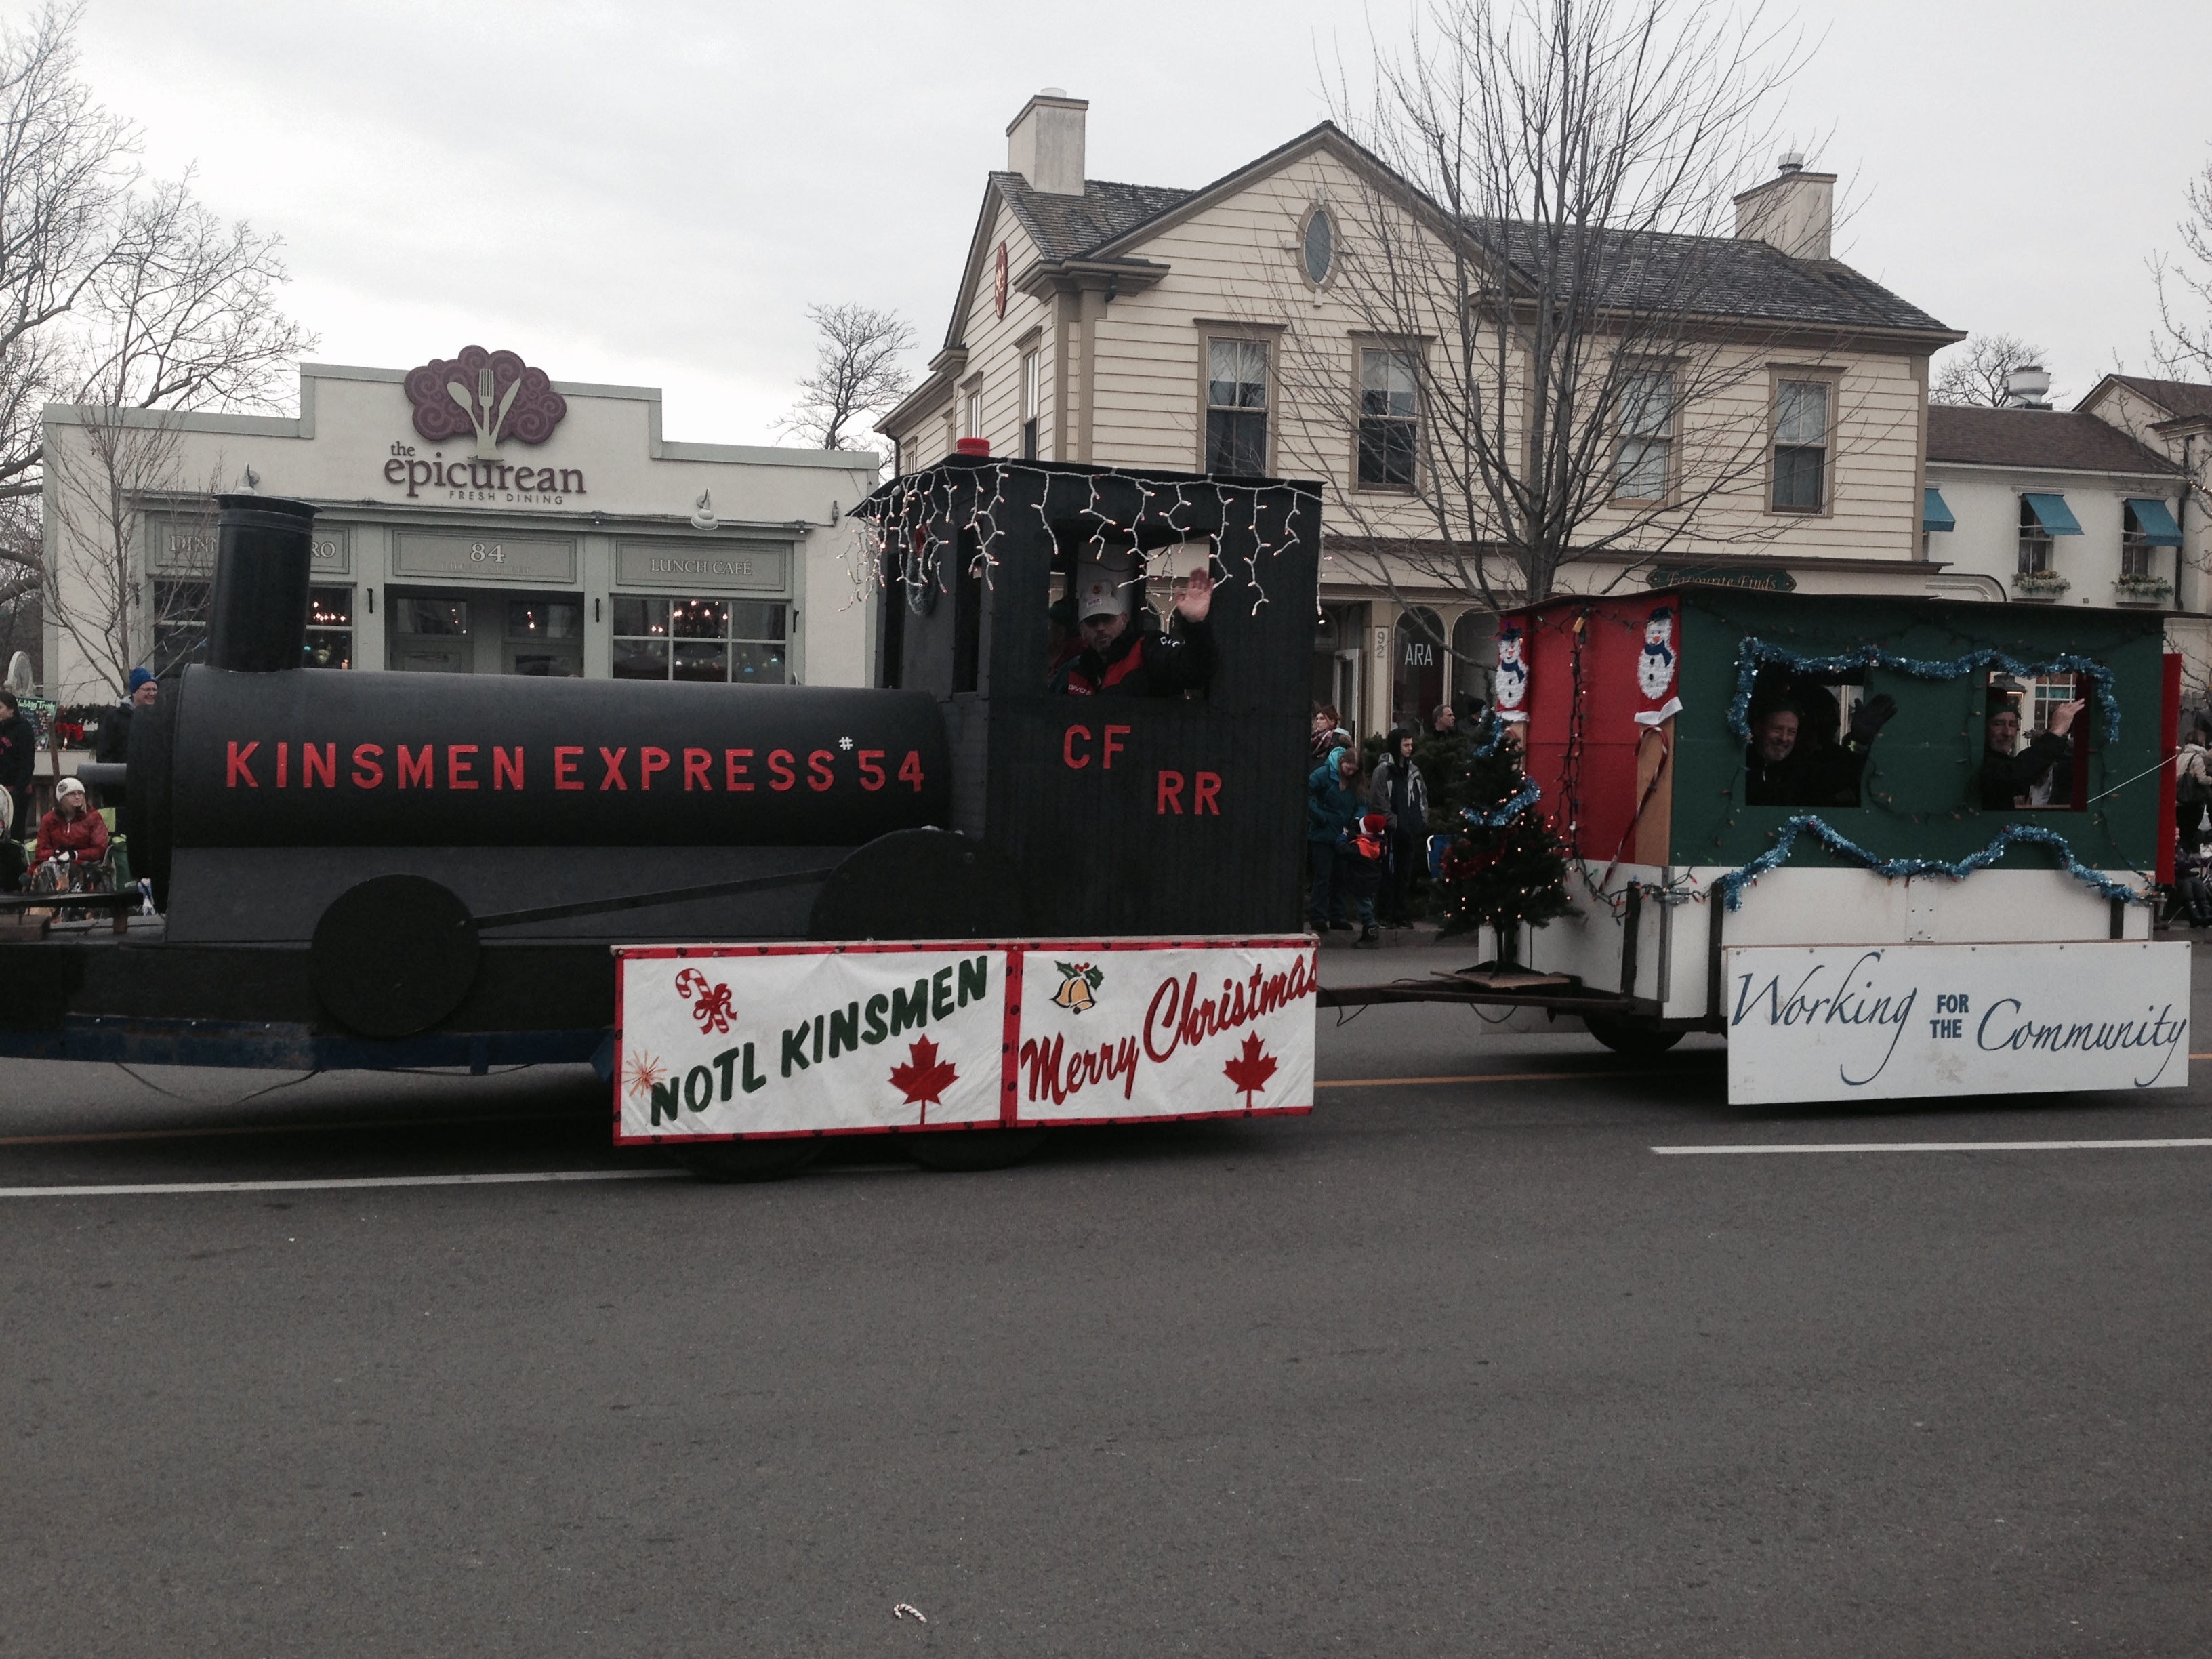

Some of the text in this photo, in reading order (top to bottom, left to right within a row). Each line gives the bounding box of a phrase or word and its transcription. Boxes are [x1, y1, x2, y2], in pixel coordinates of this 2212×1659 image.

[390, 441, 415, 456] the
[384, 451, 587, 497] epicurean
[449, 490, 563, 505] FRESH DINING
[470, 543, 506, 563] 84
[651, 559, 752, 575] LUNCH CAFÉ
[1667, 573, 1776, 590] Favourite Finds
[1404, 643, 1433, 666] ARA
[226, 741, 525, 791] KINSMEN
[554, 746, 836, 792] EXPRESS
[1063, 724, 1131, 769] CF
[1157, 770, 1222, 815] RR
[648, 955, 989, 1126] NOTL KINSMEN
[1019, 949, 1316, 1105] Merry Christmas
[1730, 951, 2187, 1088] Working FOR THE Community
